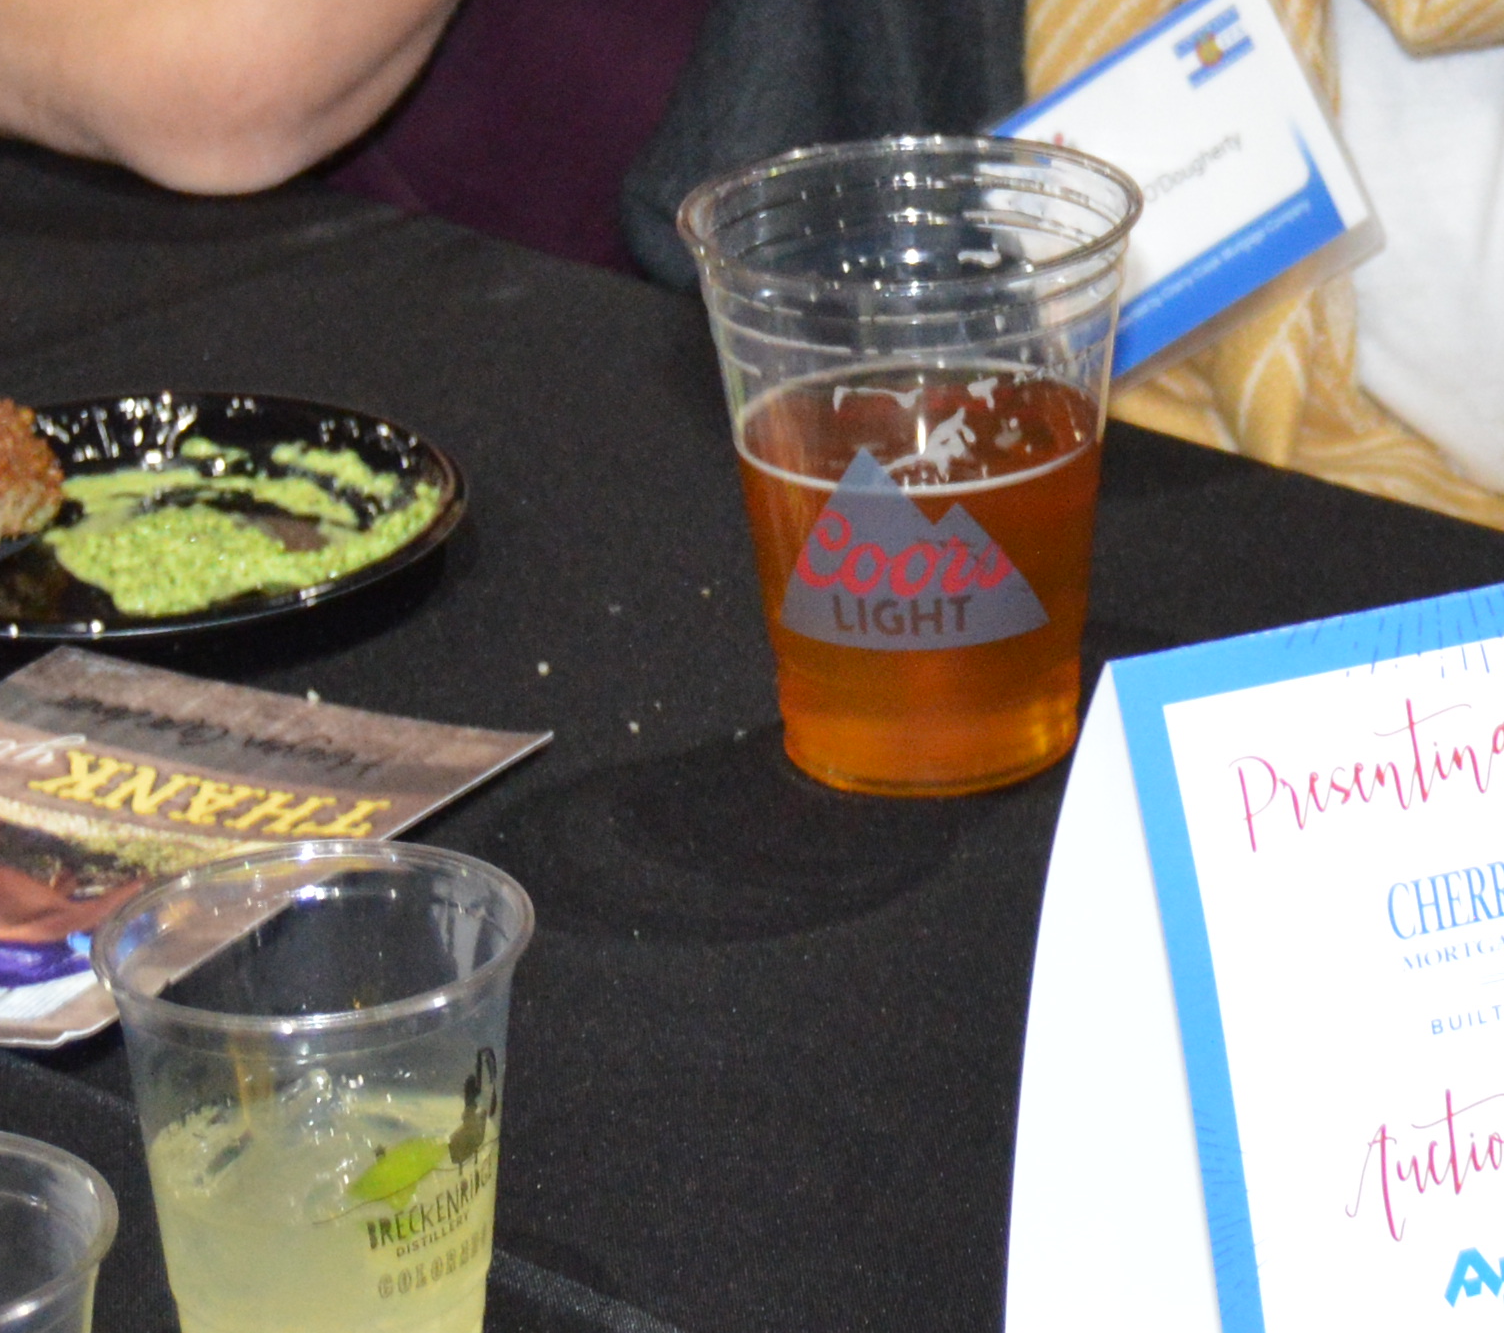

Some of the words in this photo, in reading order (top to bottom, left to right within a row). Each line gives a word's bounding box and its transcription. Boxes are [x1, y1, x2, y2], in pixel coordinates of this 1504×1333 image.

[796, 510, 1015, 596] Coors
[832, 595, 972, 636] LIGHT
[28, 748, 392, 837] THANK
[1430, 1004, 1503, 1035] BUILT
[396, 1209, 470, 1257] DISTILLERY
